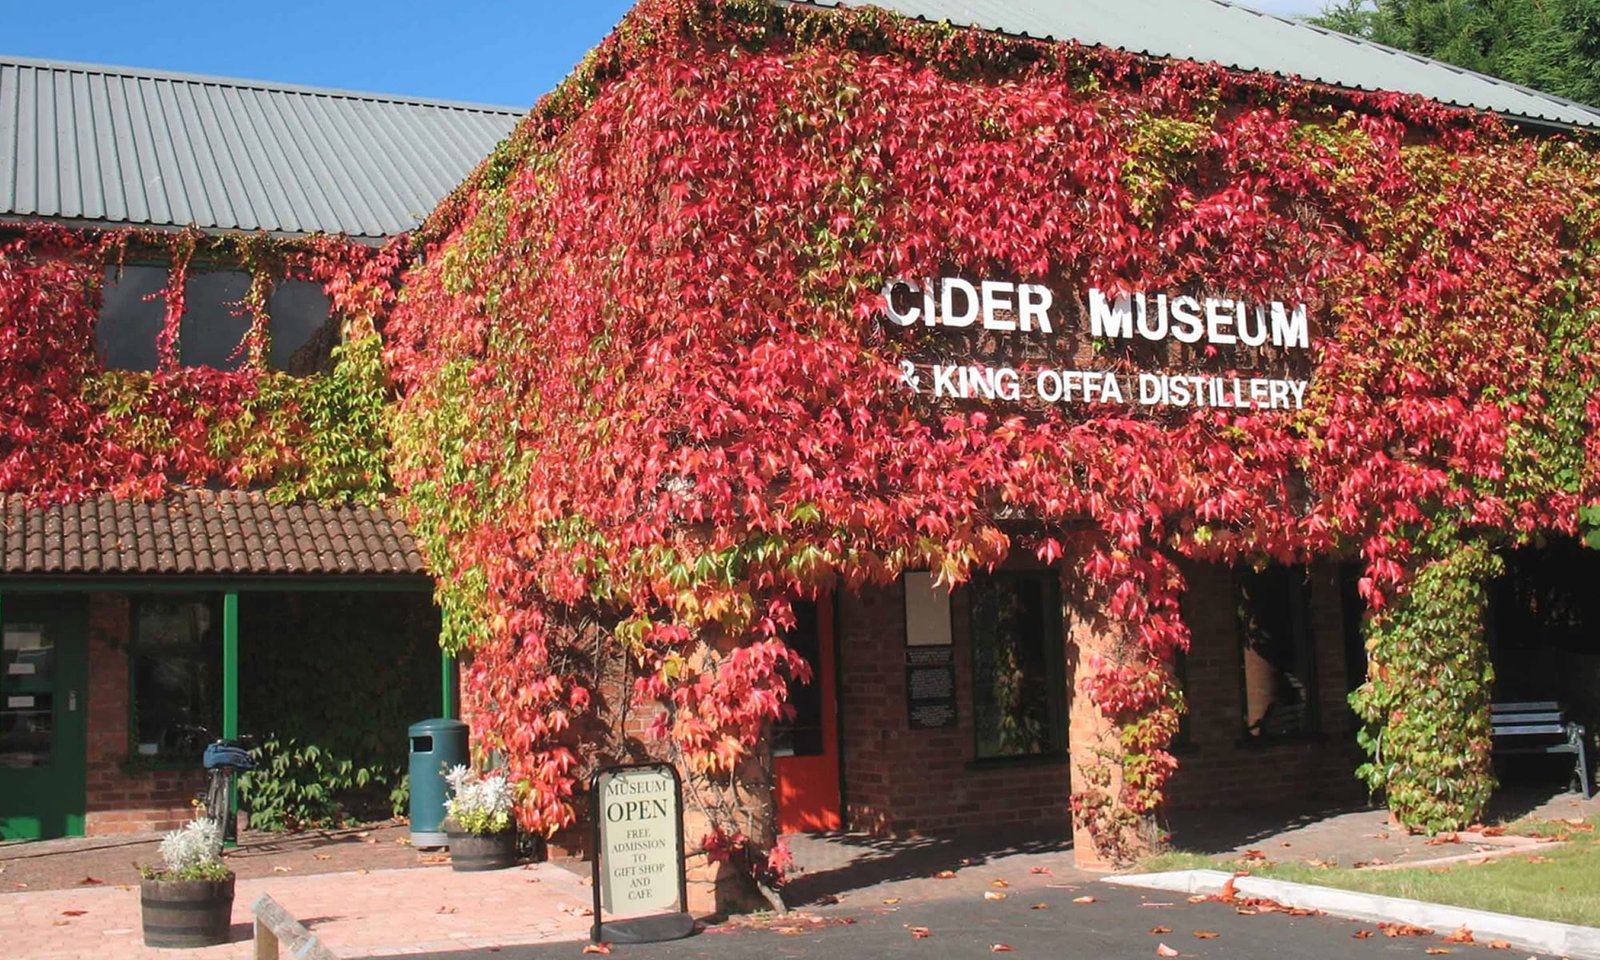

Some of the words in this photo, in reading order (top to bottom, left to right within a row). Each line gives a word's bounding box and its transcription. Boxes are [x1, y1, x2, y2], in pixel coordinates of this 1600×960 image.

[883, 276, 1053, 334] CIDER
[1089, 287, 1309, 348] MUSEUM
[899, 359, 920, 394] &
[933, 365, 1020, 401] KING
[1037, 370, 1123, 404] OFFA
[1139, 374, 1307, 410] DISTILLERY
[607, 780, 667, 797] MUSEUM
[607, 799, 667, 823] OPEN
[627, 829, 651, 839] FREE
[612, 840, 666, 853] ADMISSION
[632, 854, 647, 863] TO
[614, 867, 636, 877] GIFT
[639, 864, 665, 875] SHOP
[630, 877, 650, 888] AND
[628, 889, 652, 900] CAFE
